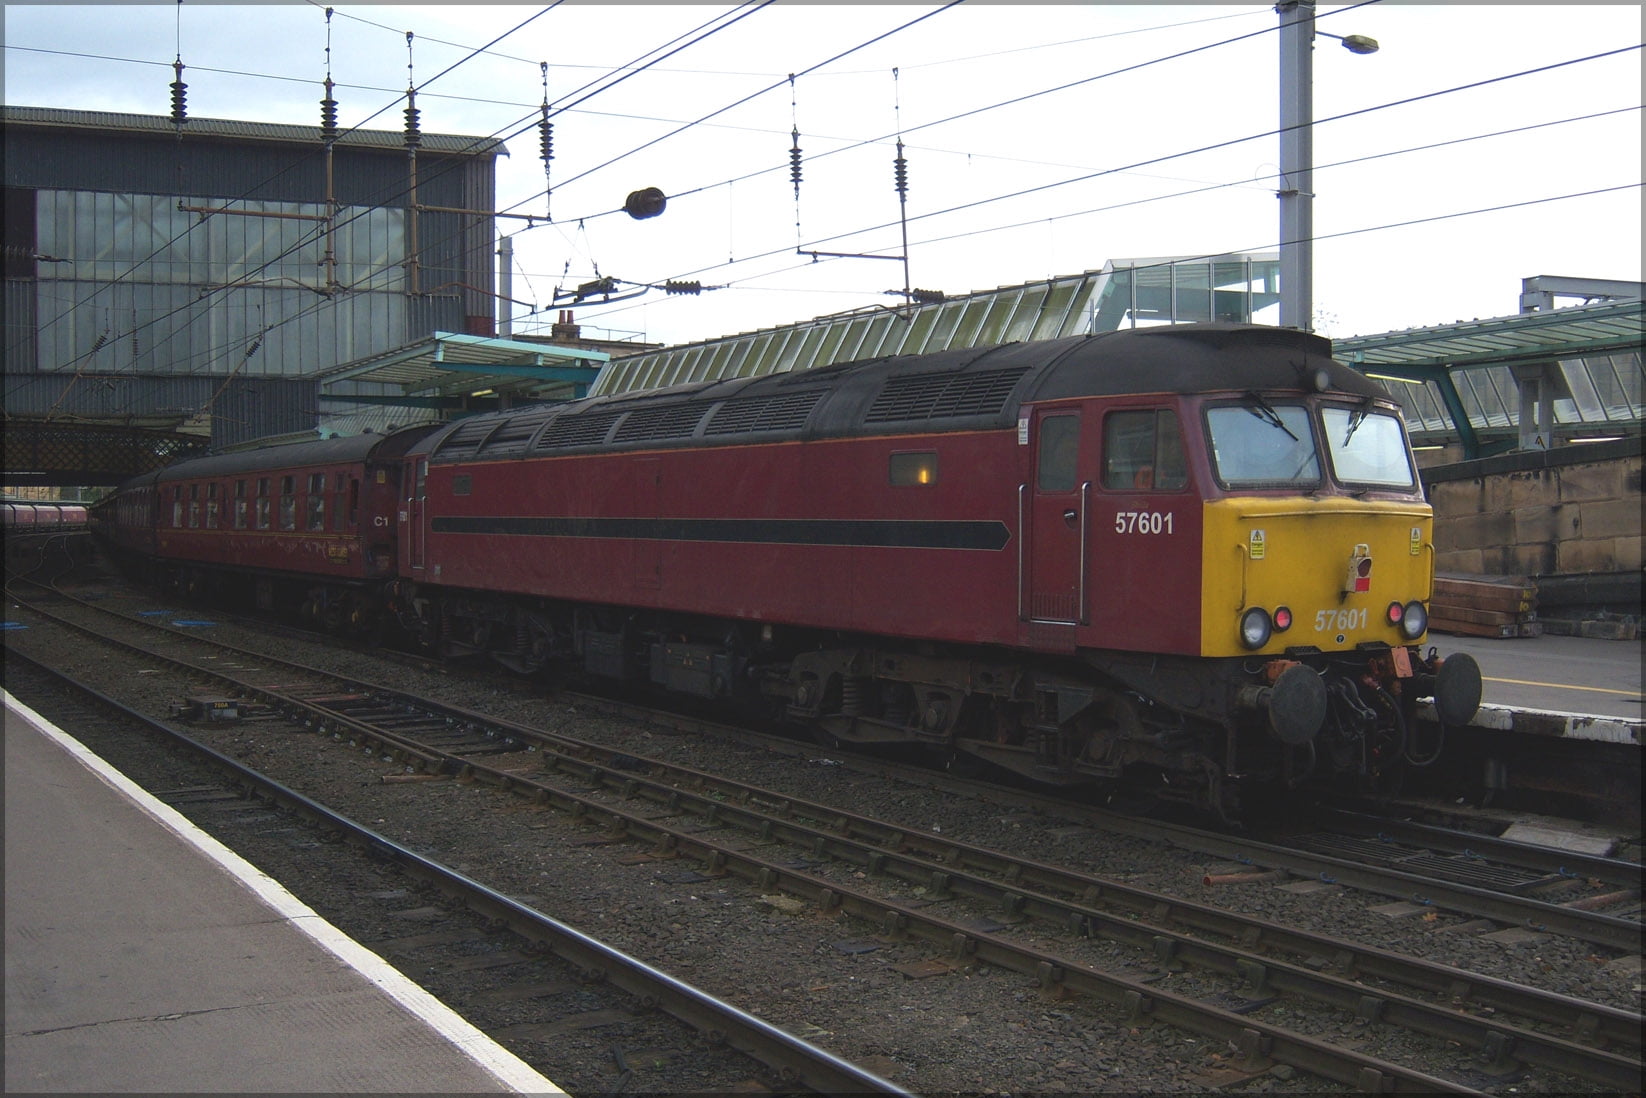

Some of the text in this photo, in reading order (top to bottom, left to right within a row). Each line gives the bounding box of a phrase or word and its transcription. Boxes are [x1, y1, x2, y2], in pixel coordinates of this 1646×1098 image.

[373, 516, 389, 527] C1
[1115, 512, 1173, 535] 57601
[1314, 608, 1368, 632] 57601
